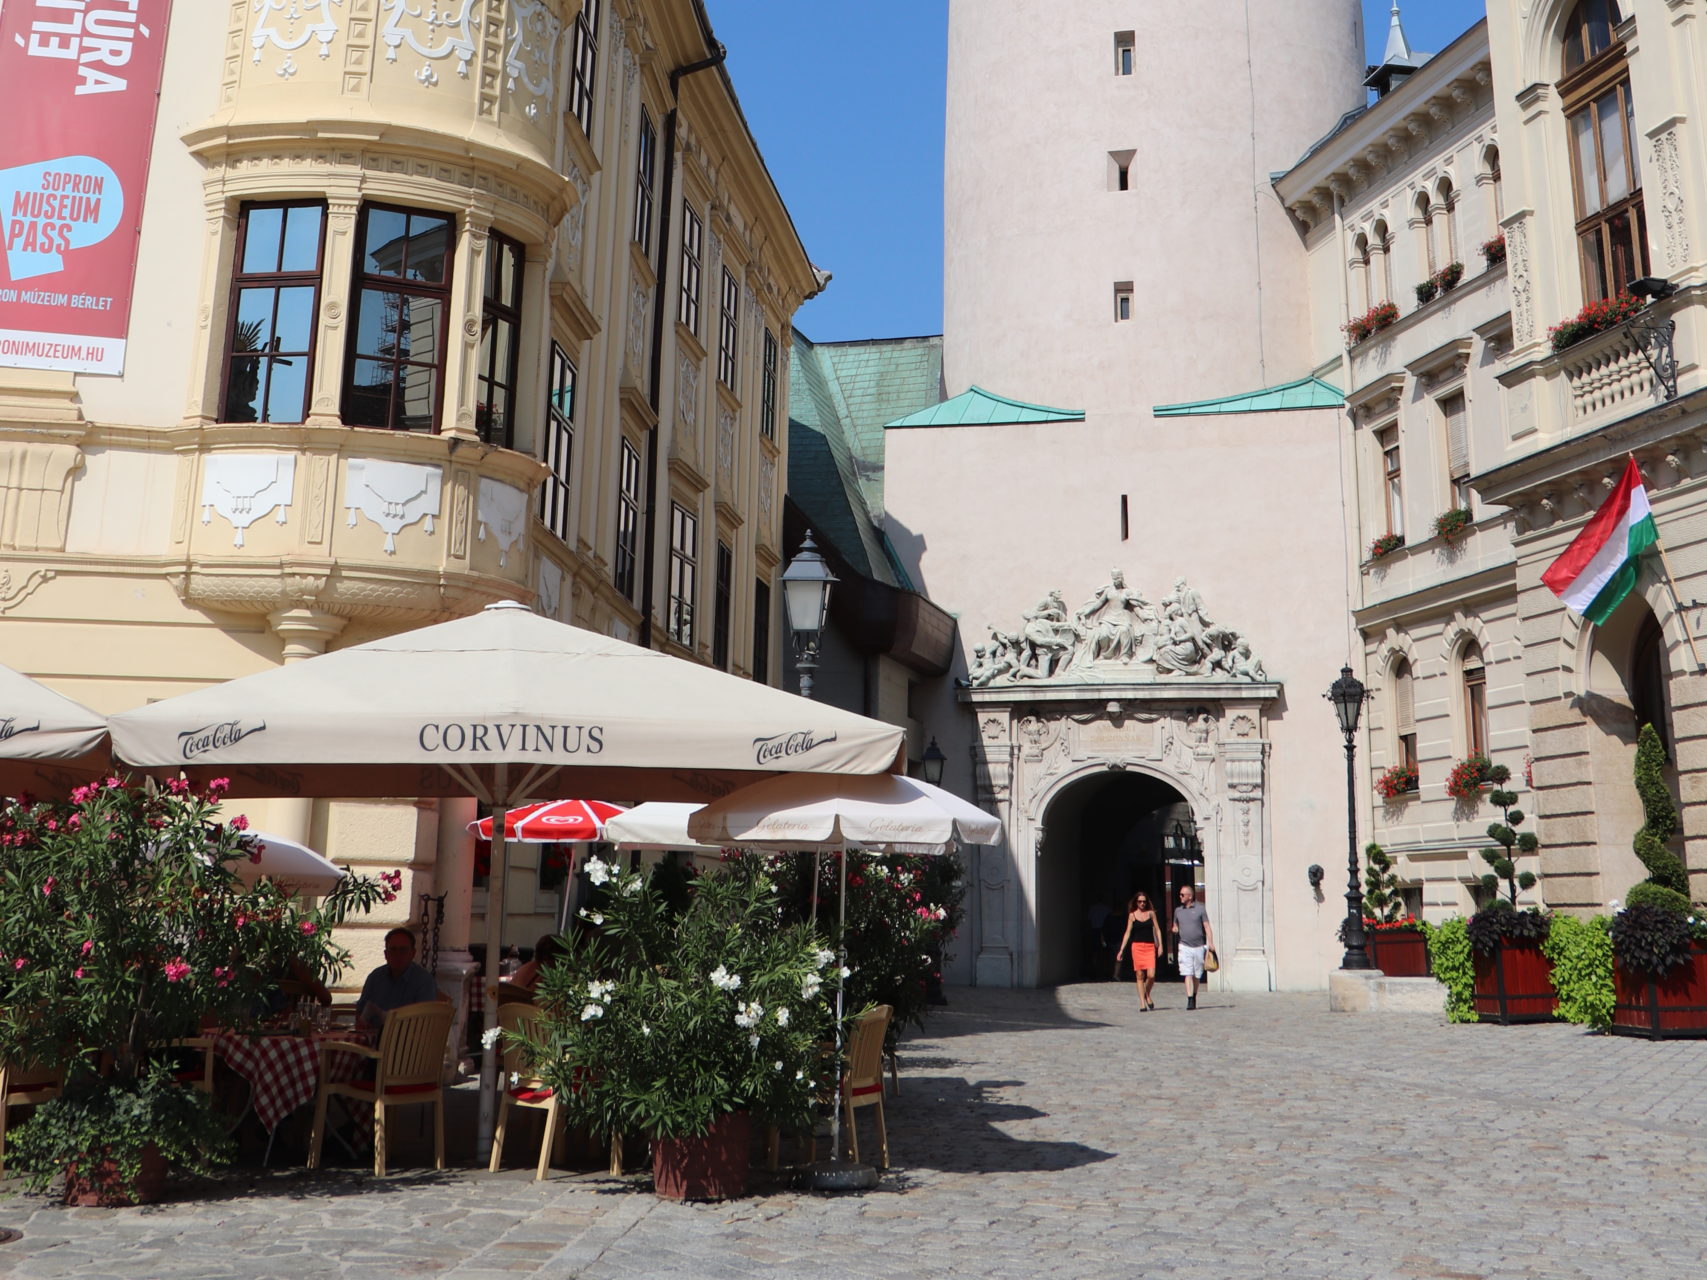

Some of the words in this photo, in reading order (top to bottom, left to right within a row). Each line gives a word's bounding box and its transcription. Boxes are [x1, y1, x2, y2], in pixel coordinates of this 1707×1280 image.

[41, 171, 104, 195] SOPRON
[12, 190, 101, 223] MUSEUM
[7, 219, 73, 256] PASS
[20, 288, 68, 308] MÚZEUM
[71, 292, 113, 311] BÉRLET
[419, 723, 604, 754] CORVINUS
